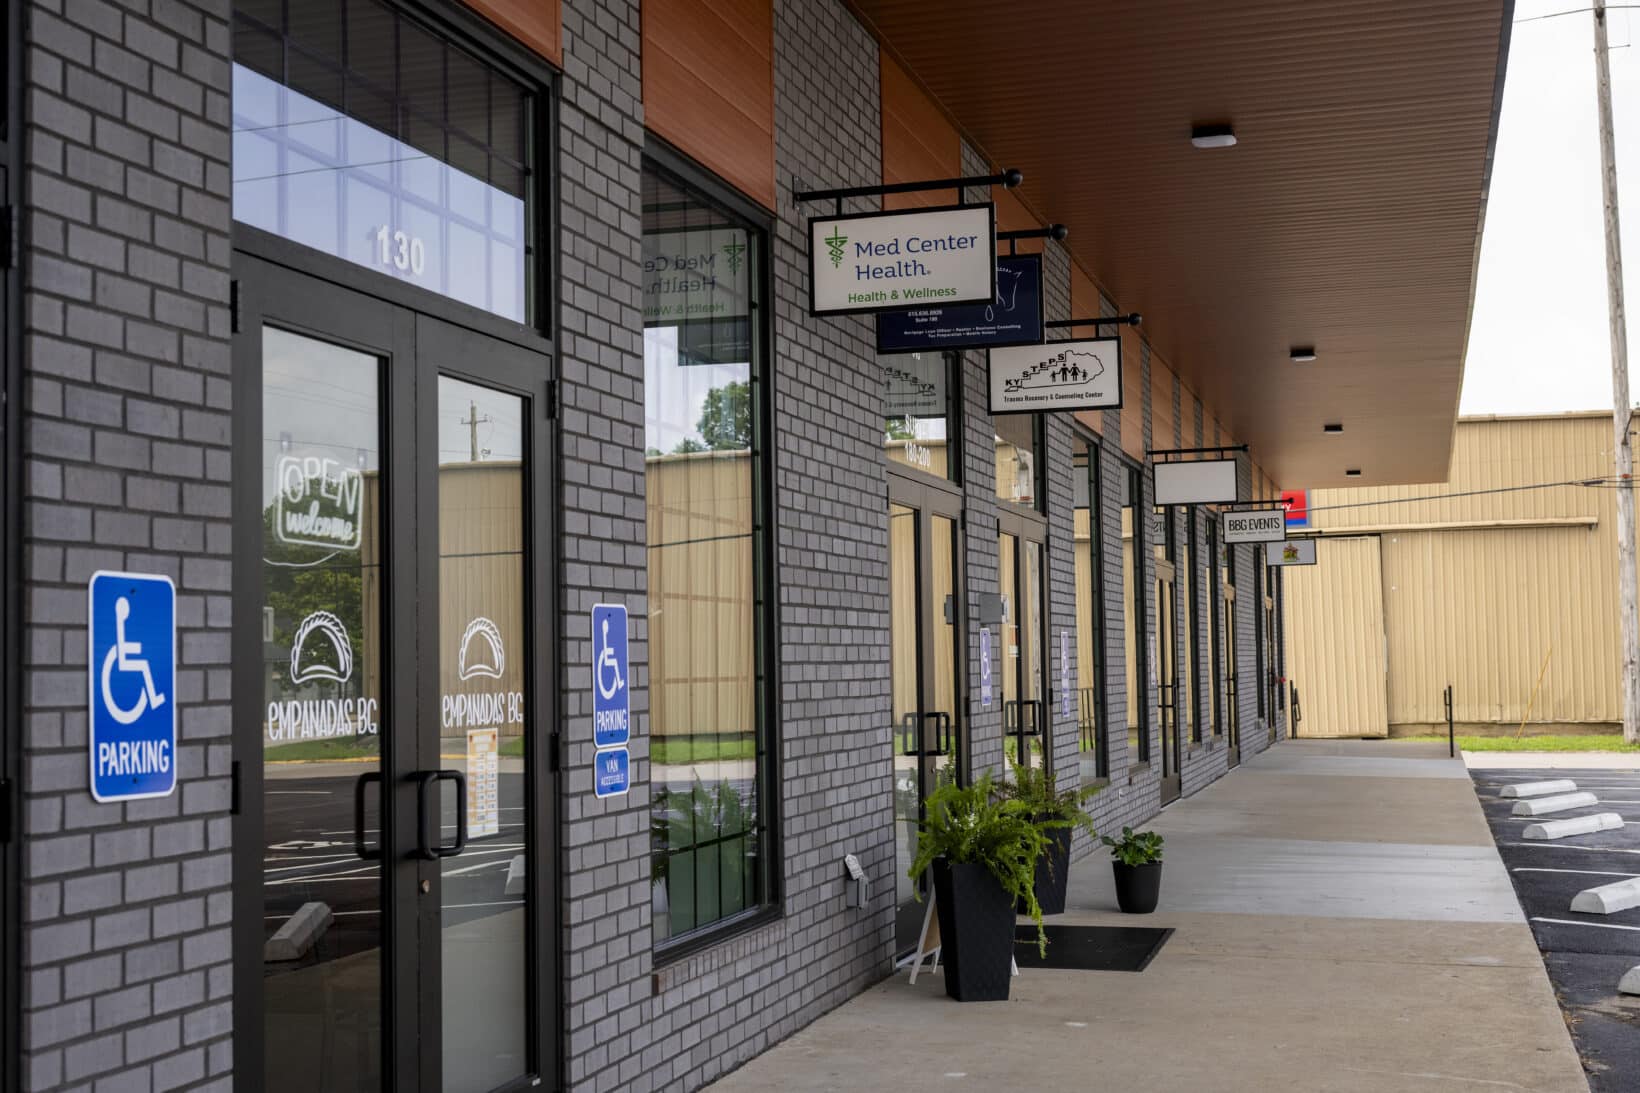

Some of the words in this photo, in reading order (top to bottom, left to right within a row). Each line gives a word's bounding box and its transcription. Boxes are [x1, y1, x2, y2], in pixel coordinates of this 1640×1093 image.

[376, 224, 425, 275] 130
[854, 239, 900, 259] Med
[905, 234, 978, 254] Center
[848, 290, 887, 304] Health
[890, 290, 899, 300] &
[903, 286, 957, 300] Wellness
[1022, 353, 1065, 378] STEPS
[1055, 391, 1084, 400] Counseling
[1085, 390, 1103, 399] Center
[282, 456, 359, 515] OPEN
[285, 500, 355, 541] welcome
[1229, 519, 1247, 531] BBG
[1248, 517, 1280, 530] EVENTS
[357, 697, 378, 734] BG
[507, 691, 524, 724] BG
[597, 709, 627, 732] PARKING
[99, 739, 170, 777] PARKING
[605, 759, 619, 773] VAN
